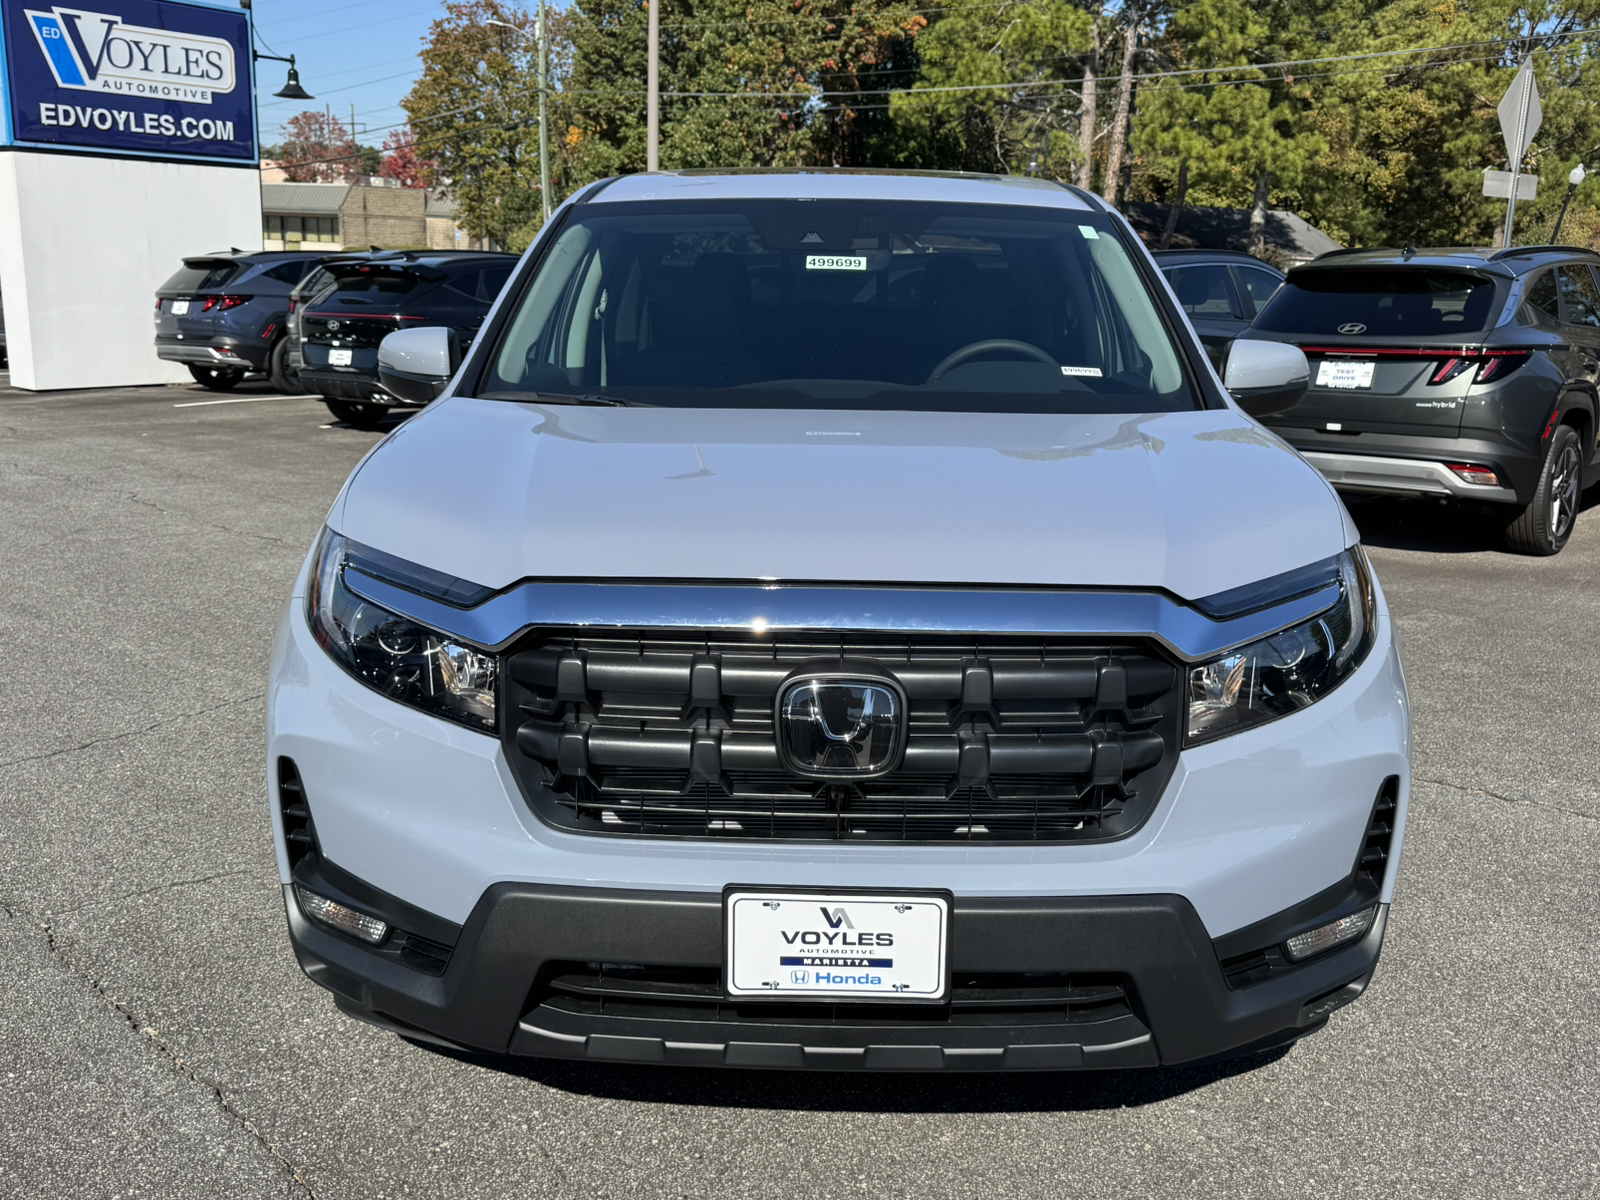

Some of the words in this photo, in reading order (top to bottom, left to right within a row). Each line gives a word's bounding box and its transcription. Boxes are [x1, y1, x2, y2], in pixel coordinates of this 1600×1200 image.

[42, 26, 61, 39] ED
[102, 79, 209, 100] AUTOMOTIVE
[39, 102, 234, 141] EDVOYLES.COM
[808, 258, 862, 268] 499699
[1432, 401, 1456, 409] hybrid
[780, 930, 894, 947] VOYLES
[803, 958, 870, 966] MARIETTA
[815, 972, 882, 985] Honda
